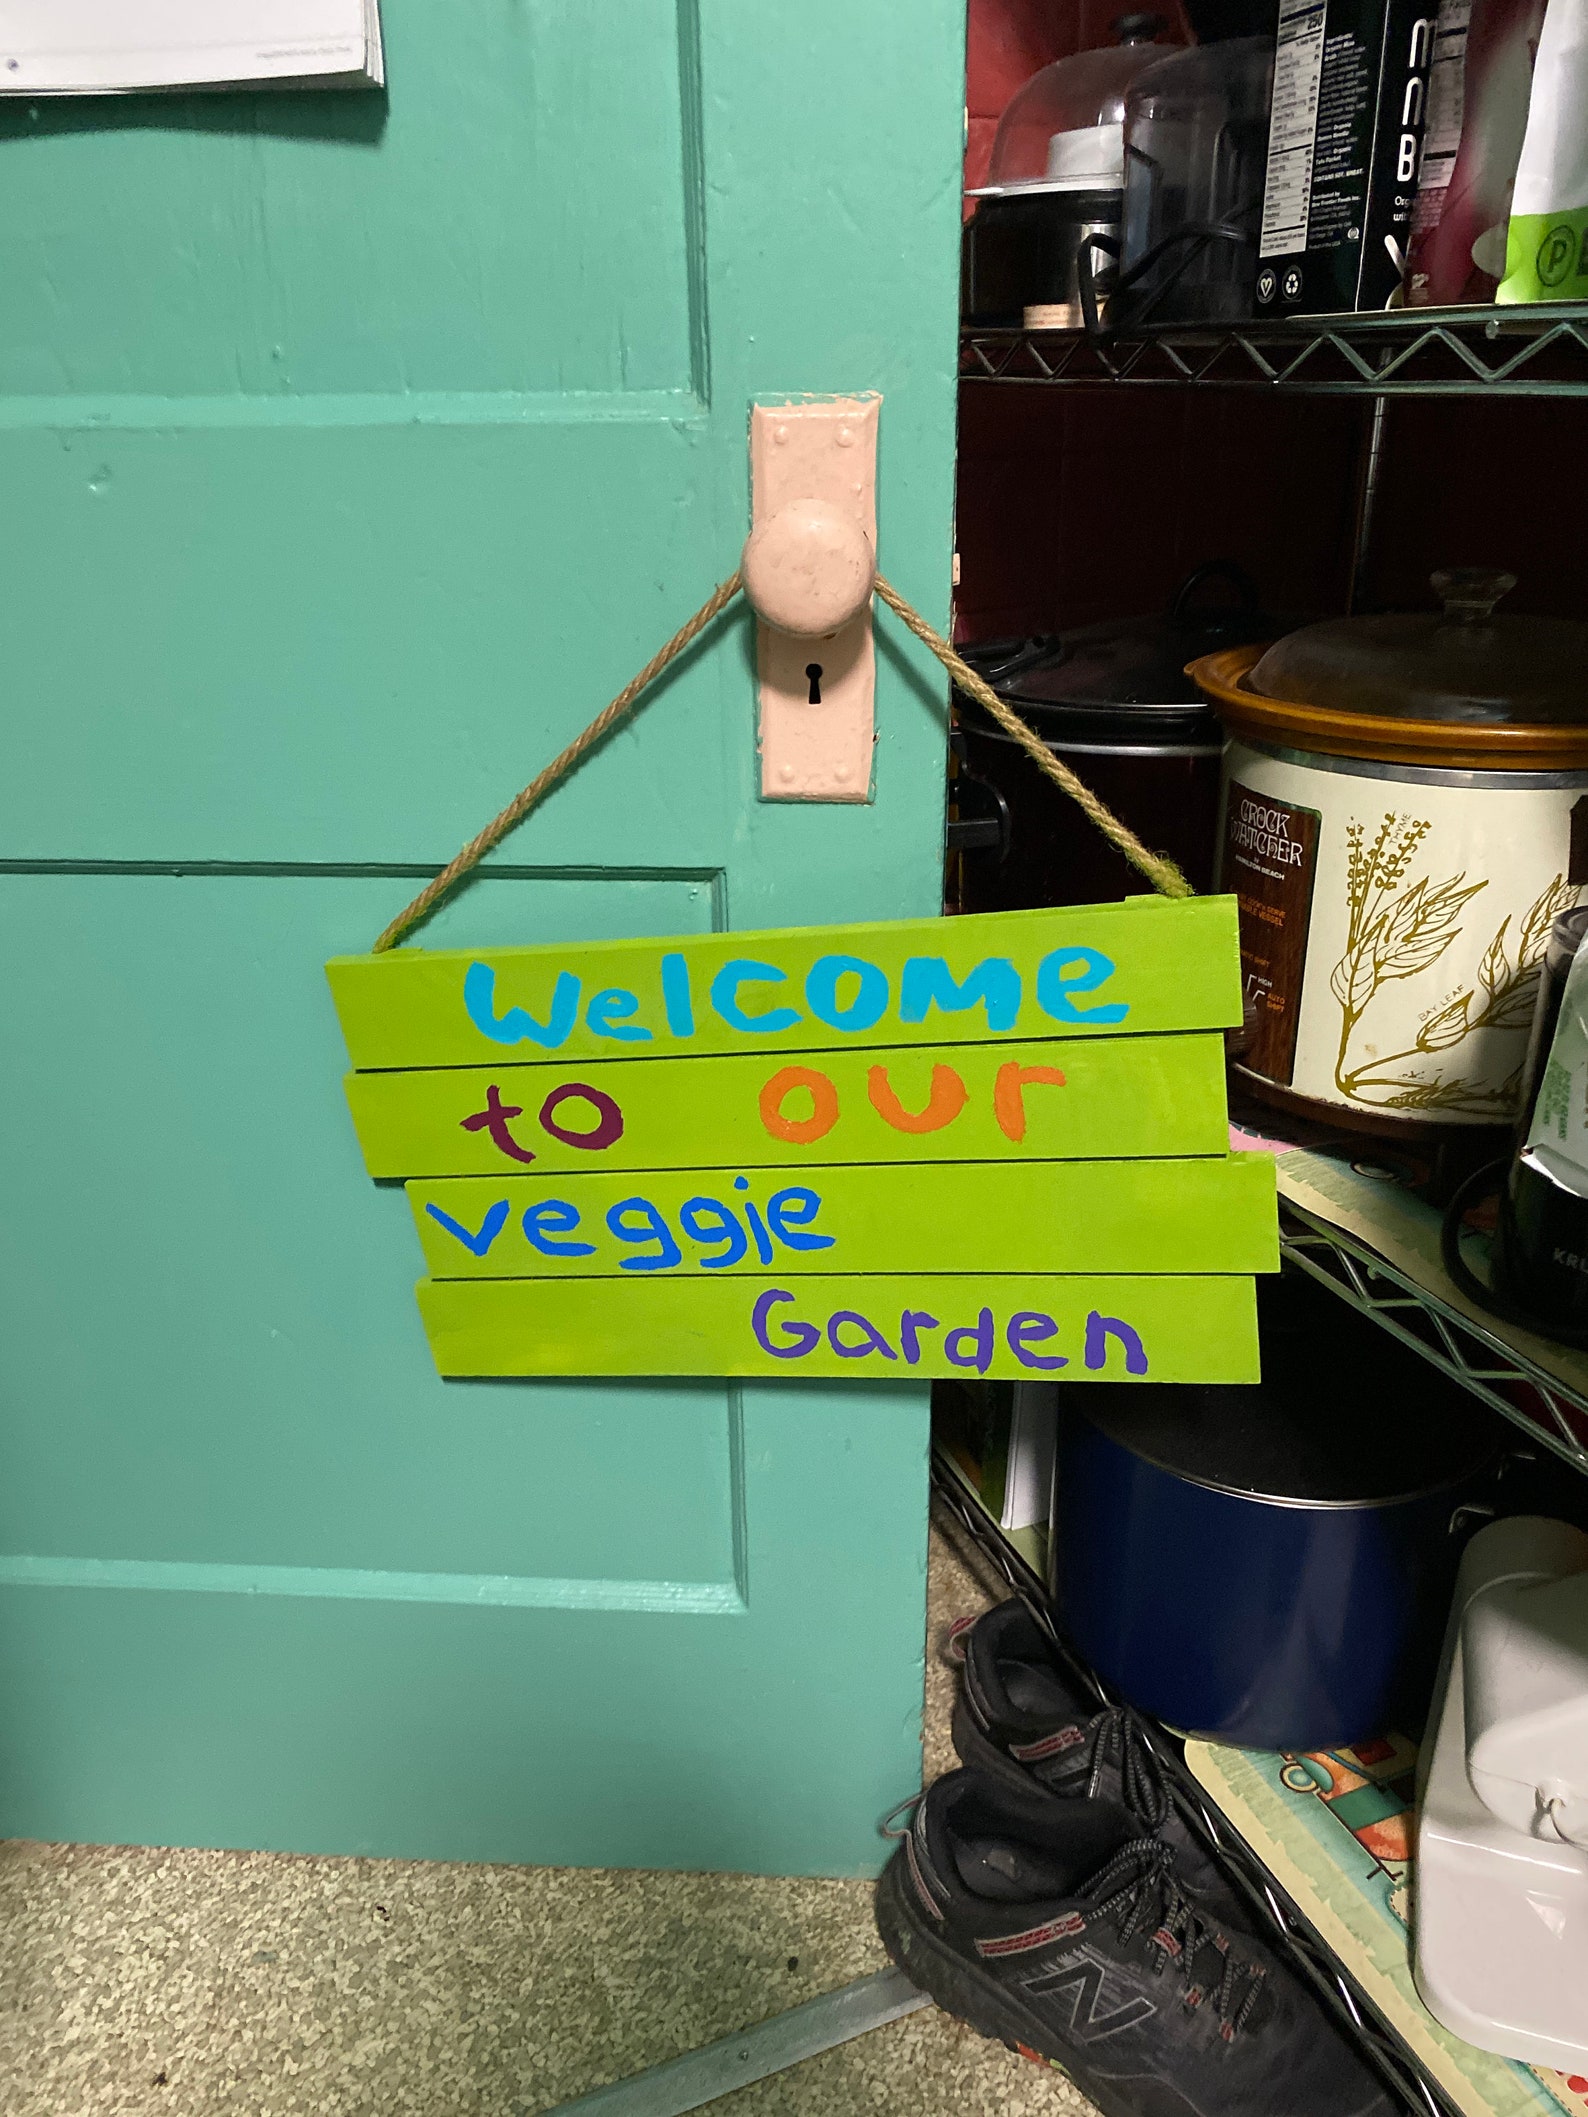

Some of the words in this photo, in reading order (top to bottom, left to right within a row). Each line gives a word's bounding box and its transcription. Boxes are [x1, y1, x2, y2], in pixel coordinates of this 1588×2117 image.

[1230, 816, 1303, 867] WATCHER
[1240, 799, 1290, 838] CROCK
[1388, 812, 1412, 844] THYME
[464, 946, 1129, 1048] Welcome
[1417, 1004, 1437, 1022] BAY
[1440, 984, 1465, 1006] LEAF
[460, 1083, 624, 1165] to
[758, 1061, 1067, 1145] our
[426, 1176, 837, 1272] veggie
[751, 1288, 1149, 1376] Garden
